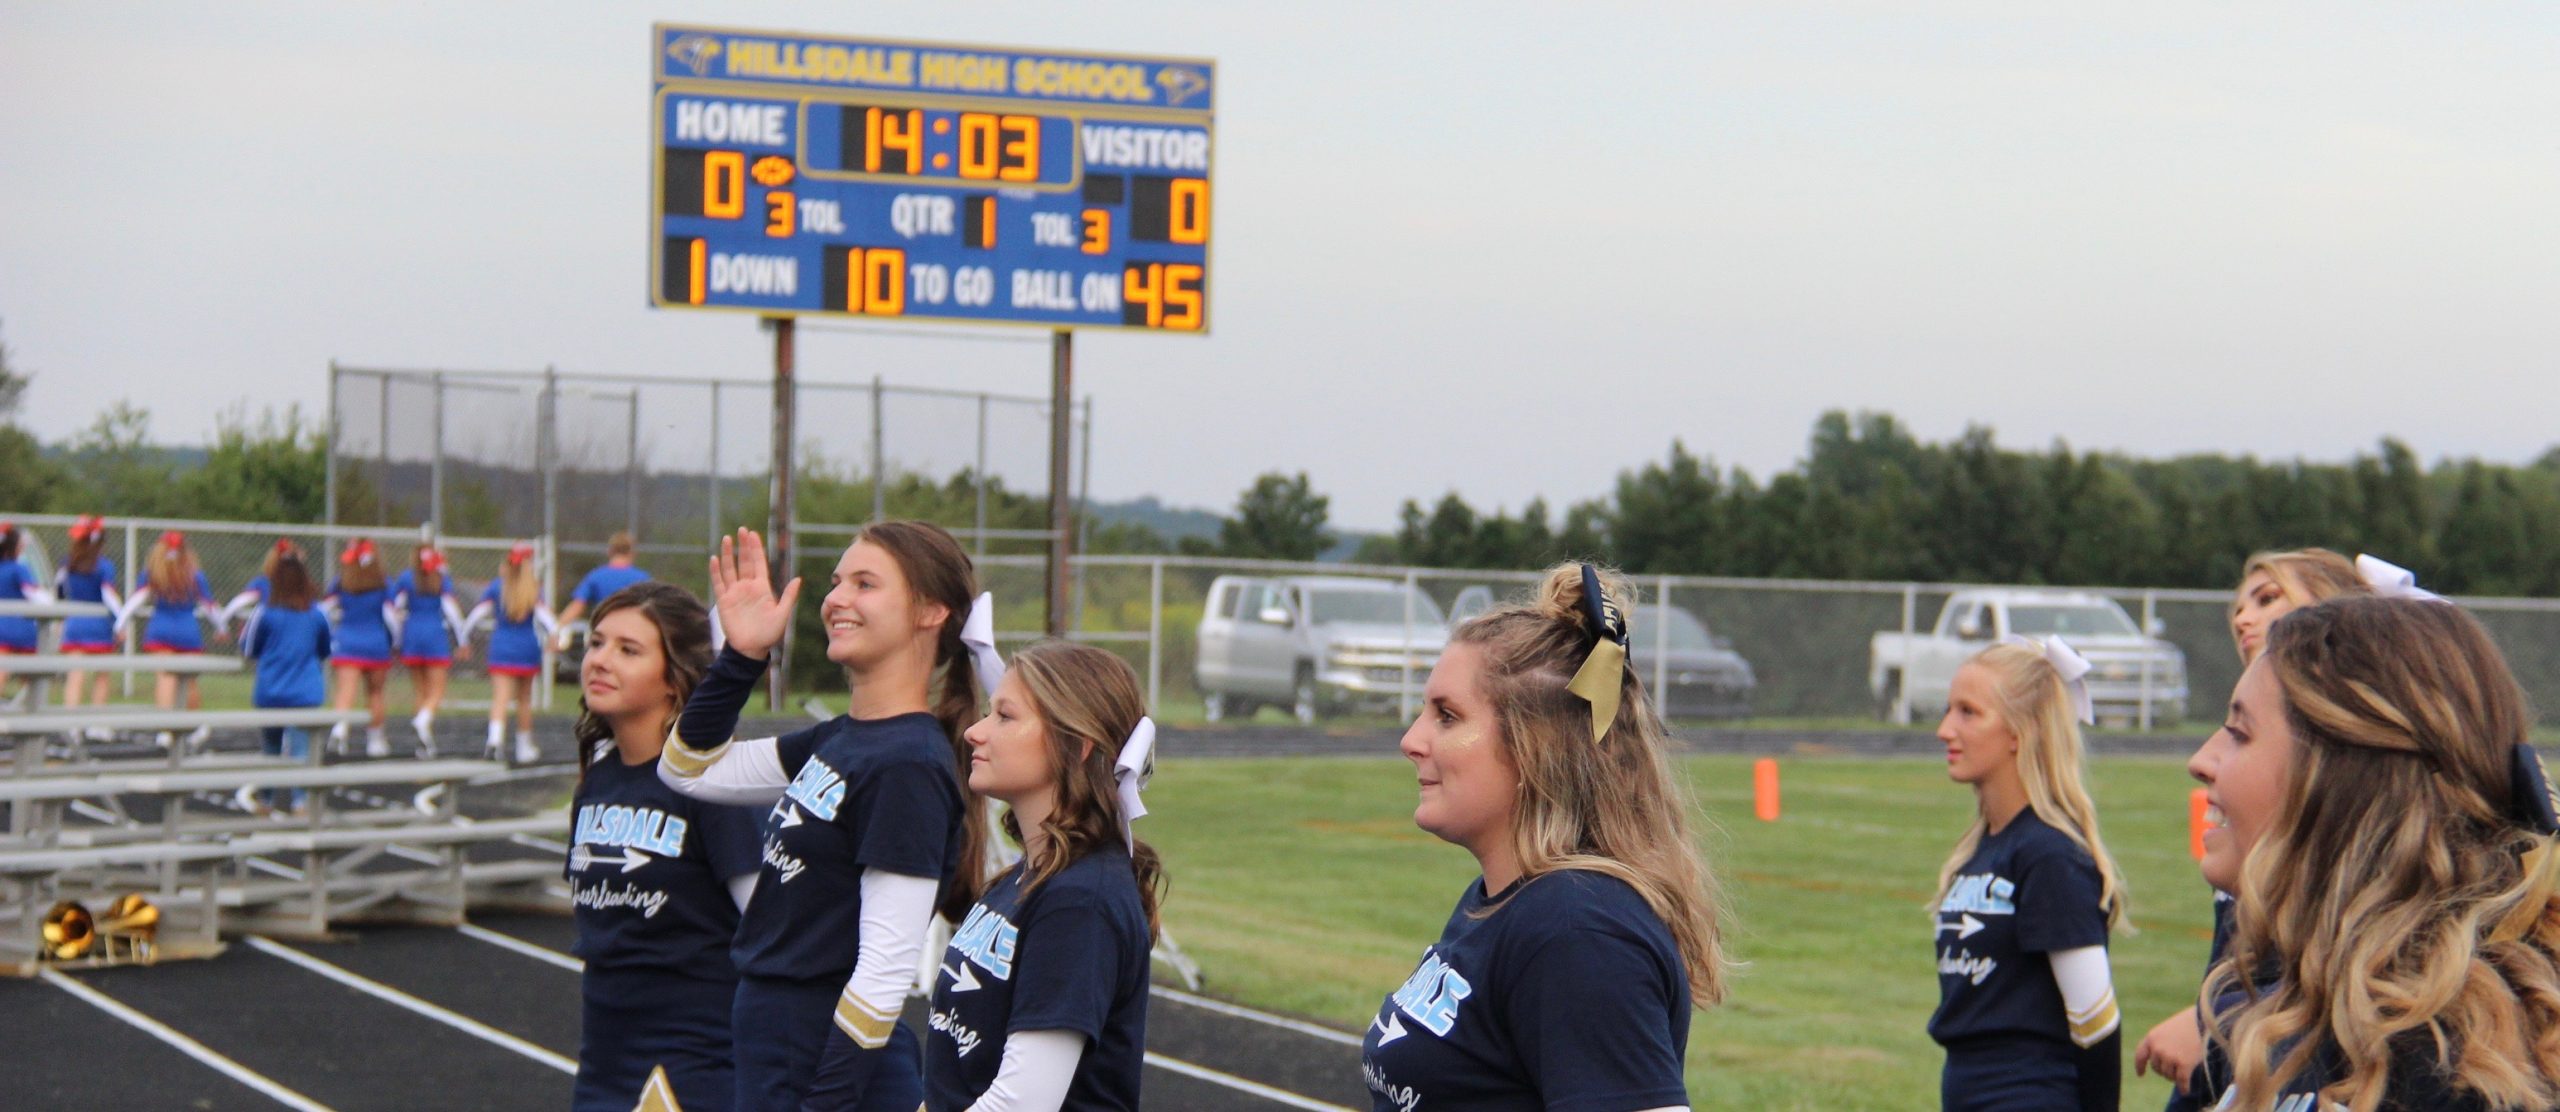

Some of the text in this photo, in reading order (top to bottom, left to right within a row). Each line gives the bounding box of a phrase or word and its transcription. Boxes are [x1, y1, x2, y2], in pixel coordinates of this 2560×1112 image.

[726, 40, 1153, 101] HILLSDALE HIGH SCHOOL
[676, 99, 788, 147] HOME
[864, 105, 1041, 182] 14:03
[1080, 124, 1210, 170] VISITOR
[704, 151, 745, 220] 0
[765, 191, 847, 238] 3 TOL
[1169, 177, 1208, 244] 0
[890, 192, 997, 250] QTR 1
[1030, 208, 1111, 255] TOL 3
[690, 237, 798, 305] 1 DOWN
[848, 246, 995, 315] 10 TO GO
[1010, 262, 1204, 330] BALL ON 45
